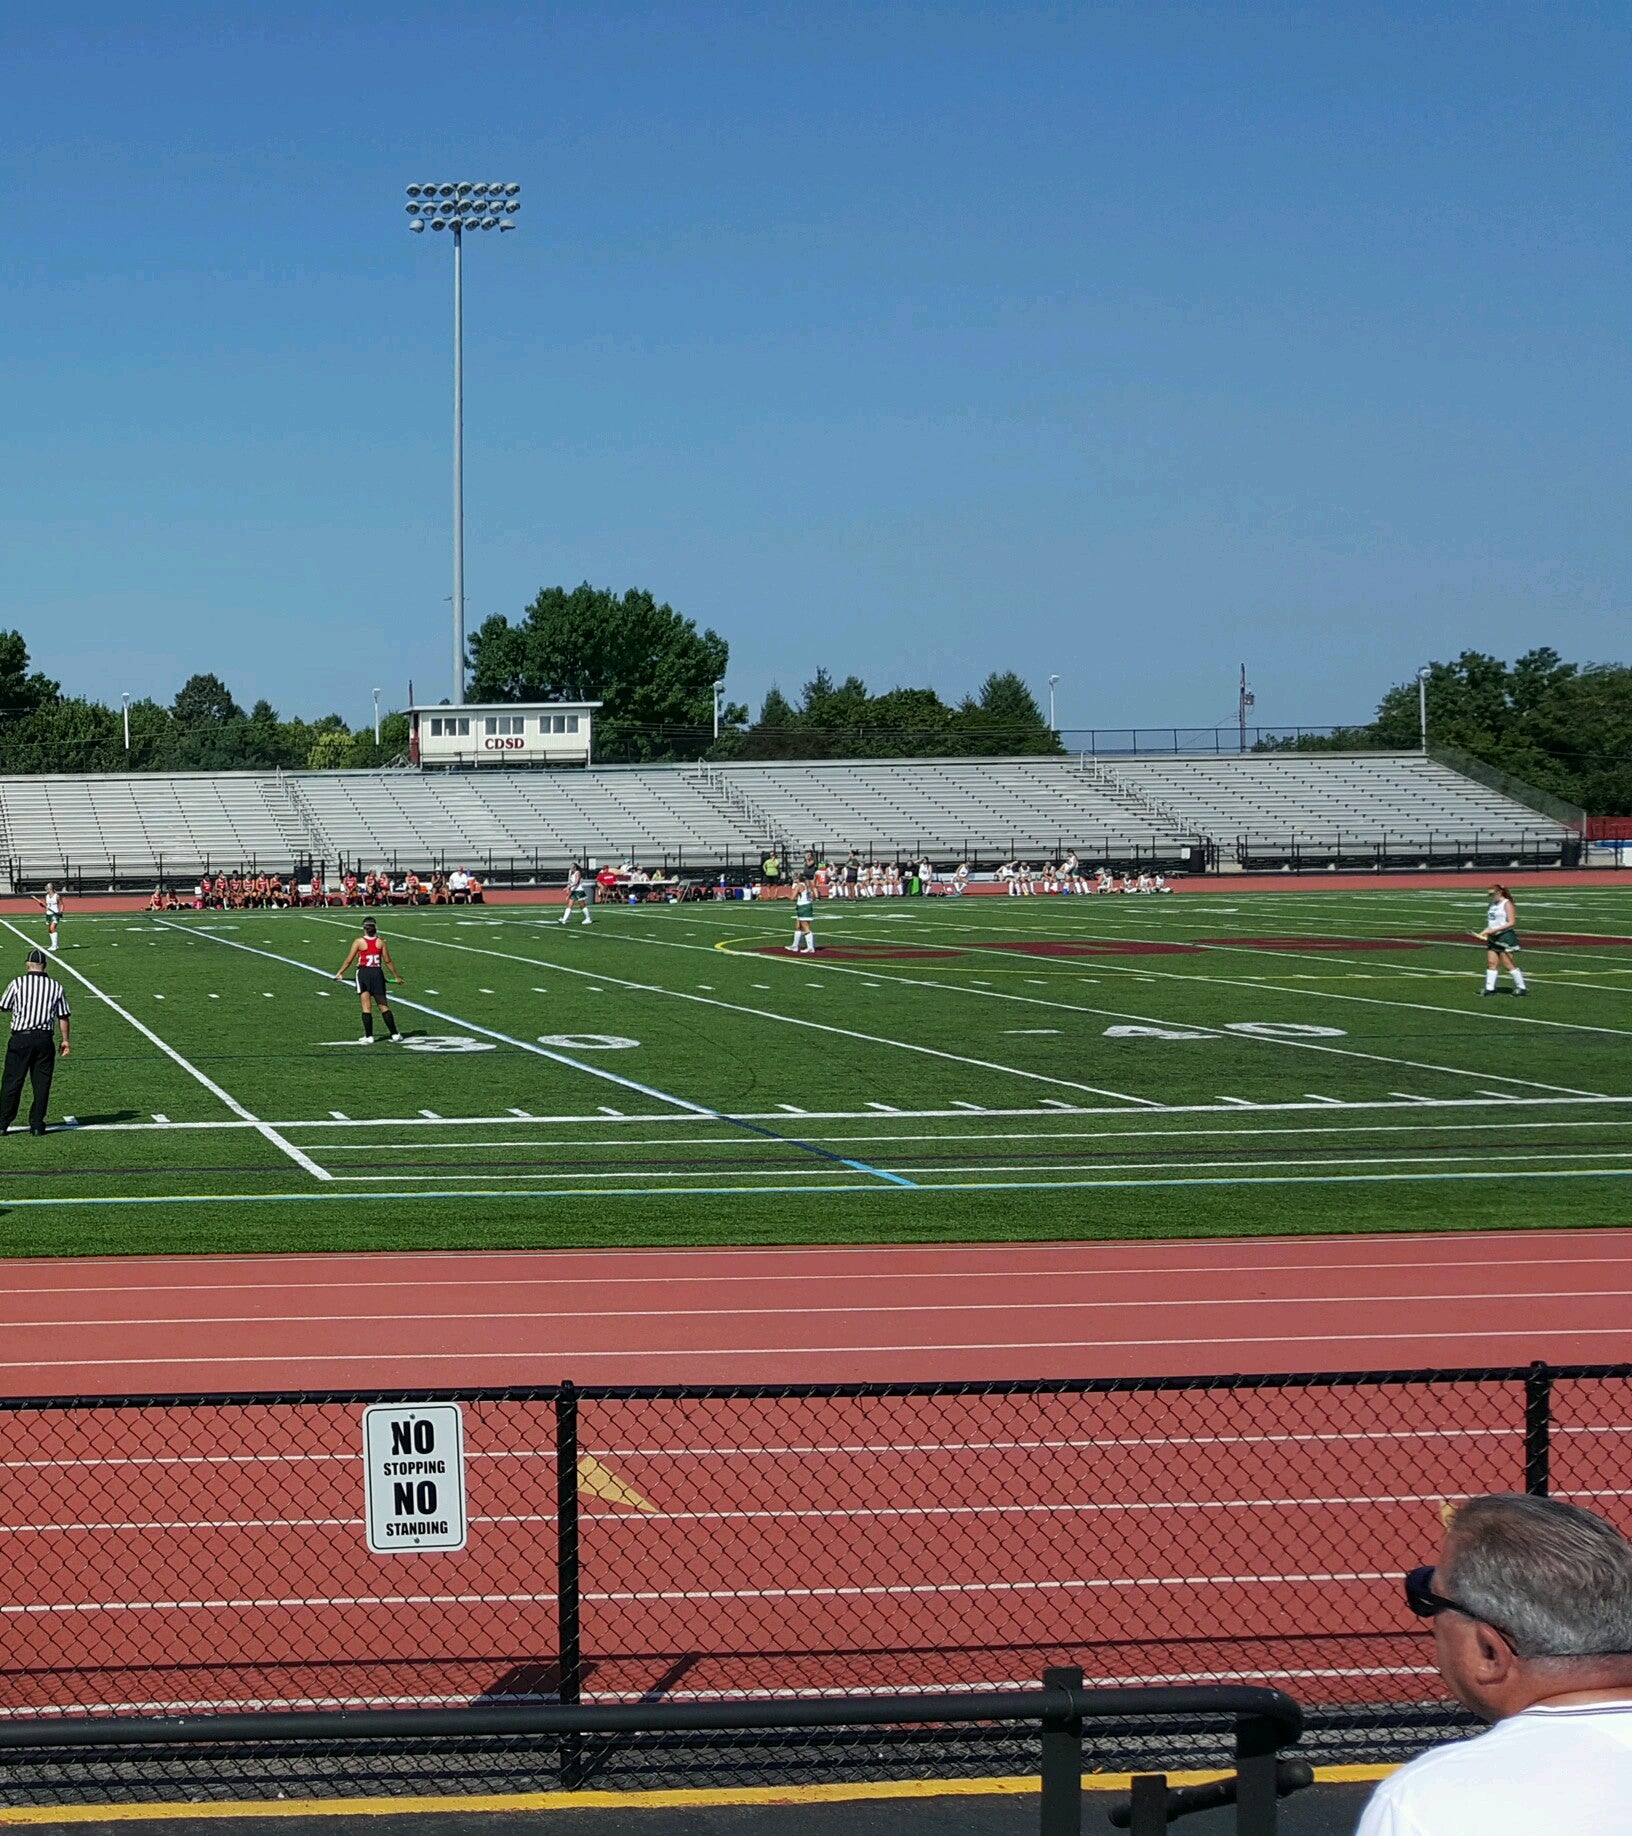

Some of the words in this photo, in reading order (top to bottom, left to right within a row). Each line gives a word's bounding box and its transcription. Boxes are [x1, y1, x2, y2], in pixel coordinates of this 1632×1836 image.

[484, 738, 525, 750] CDSD
[391, 1419, 434, 1456] NO
[383, 1460, 446, 1476] STOPPING
[393, 1480, 437, 1516] NO
[386, 1520, 448, 1537] STANDING
